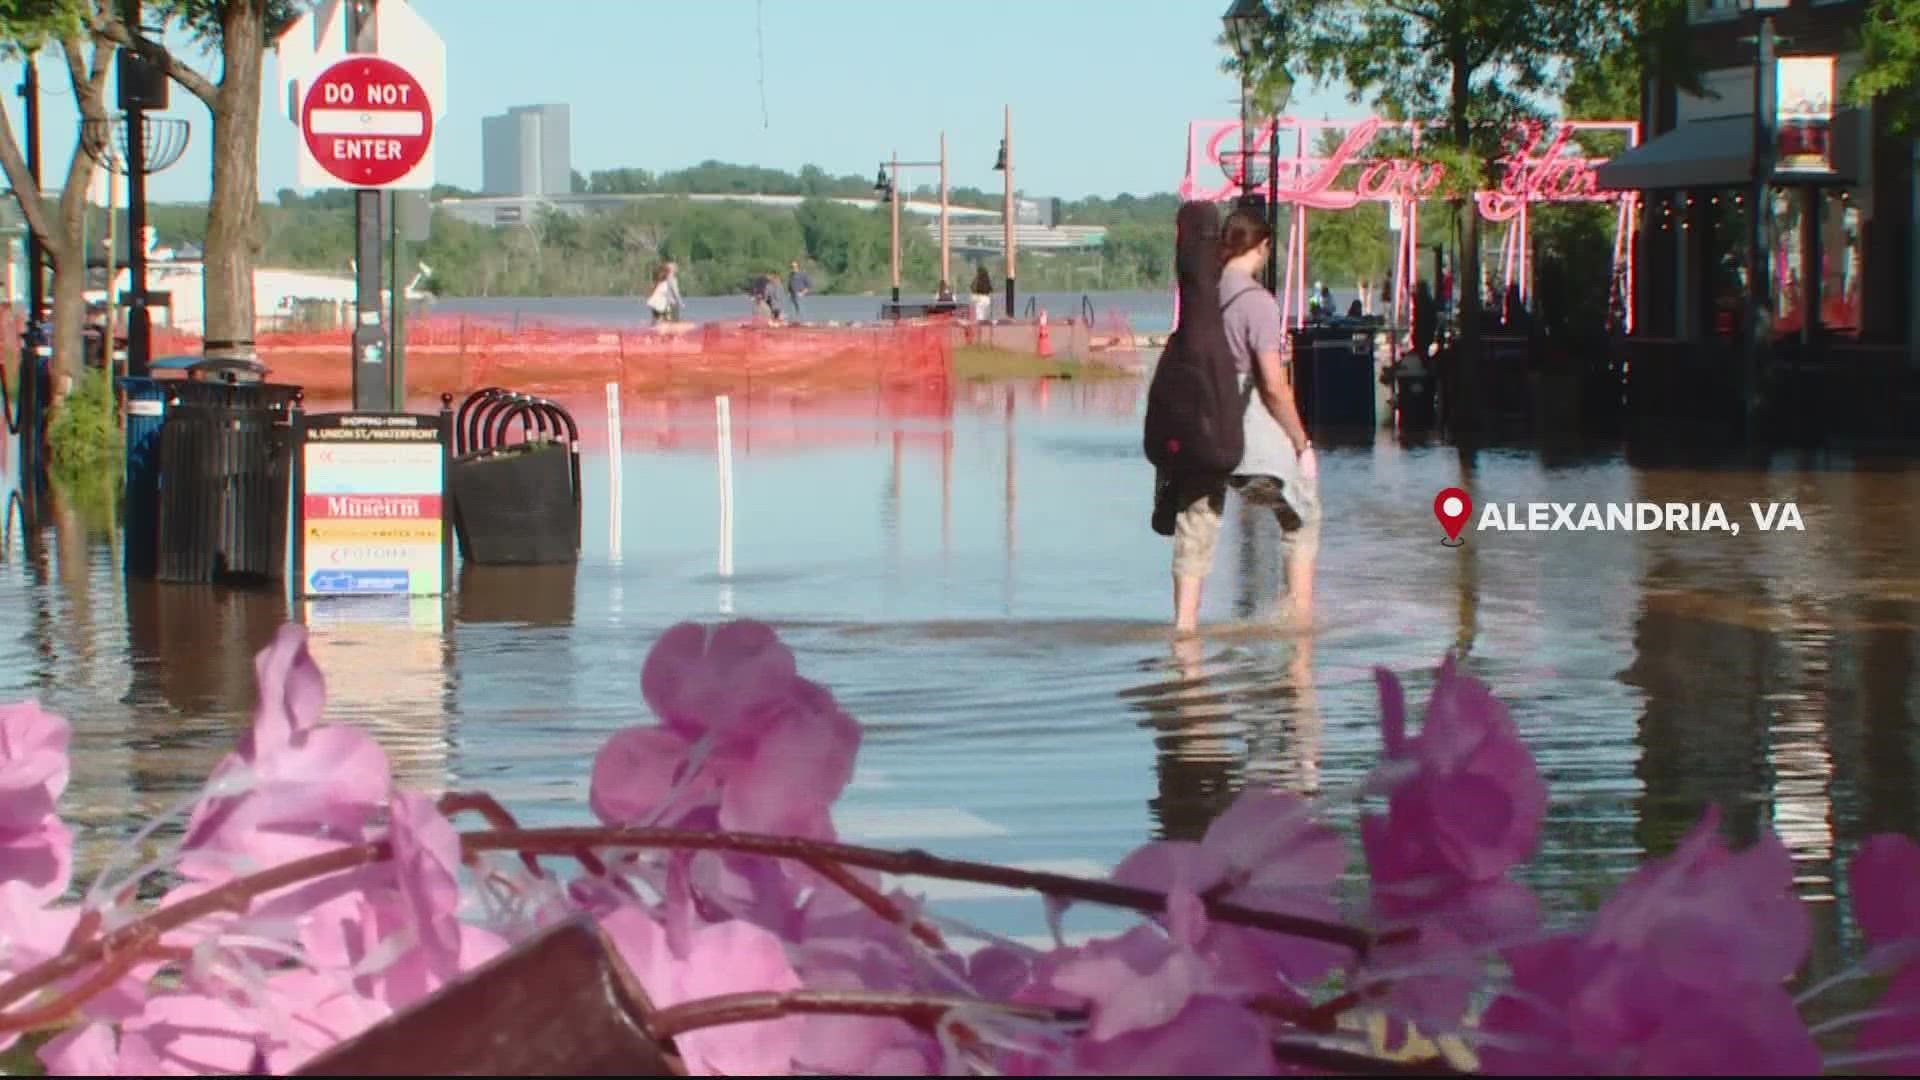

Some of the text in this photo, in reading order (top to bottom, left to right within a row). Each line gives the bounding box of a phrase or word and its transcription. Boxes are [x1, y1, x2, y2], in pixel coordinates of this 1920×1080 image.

[324, 83, 411, 104] DO NOT
[333, 139, 403, 160] ENTER
[321, 429, 353, 440] UNION
[327, 496, 420, 517] Museum
